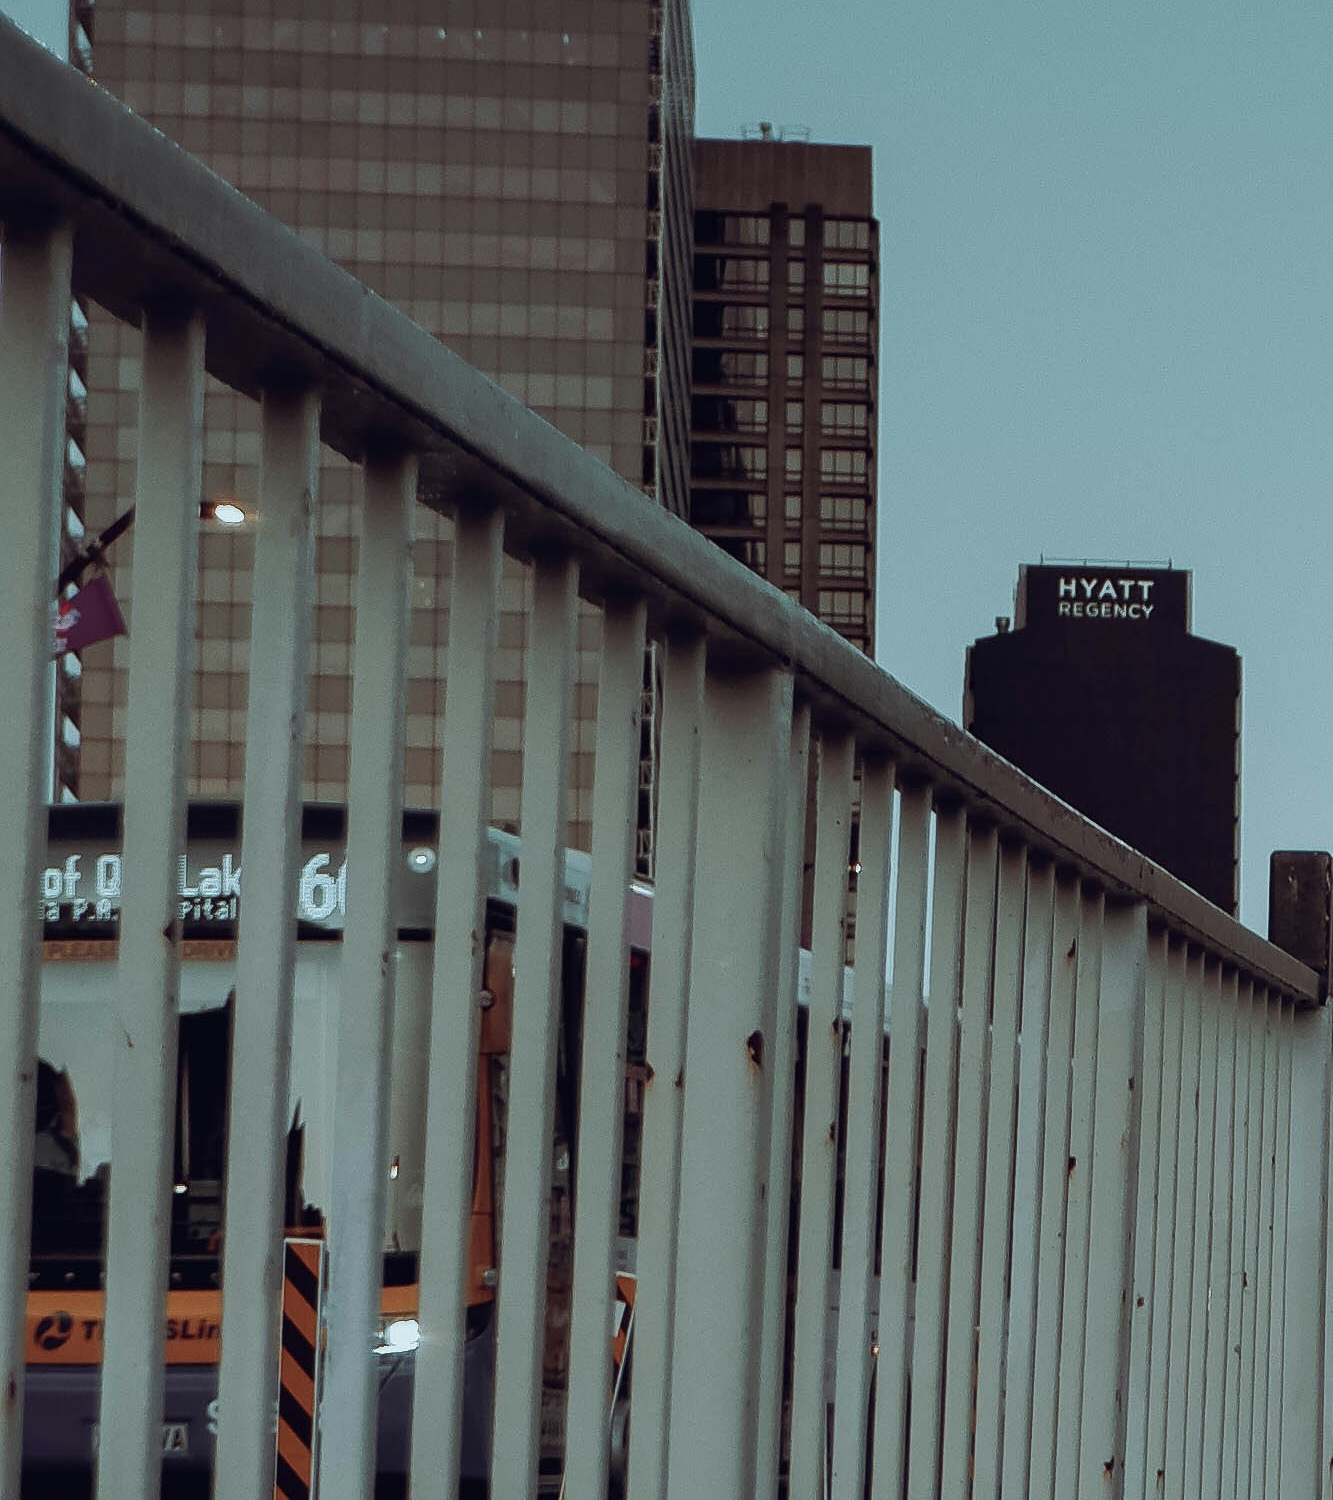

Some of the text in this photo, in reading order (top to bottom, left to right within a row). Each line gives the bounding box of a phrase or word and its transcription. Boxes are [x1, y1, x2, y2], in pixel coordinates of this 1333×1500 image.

[1059, 576, 1154, 601] HYATT
[1059, 602, 1154, 619] REGENCY
[40, 854, 81, 898] of
